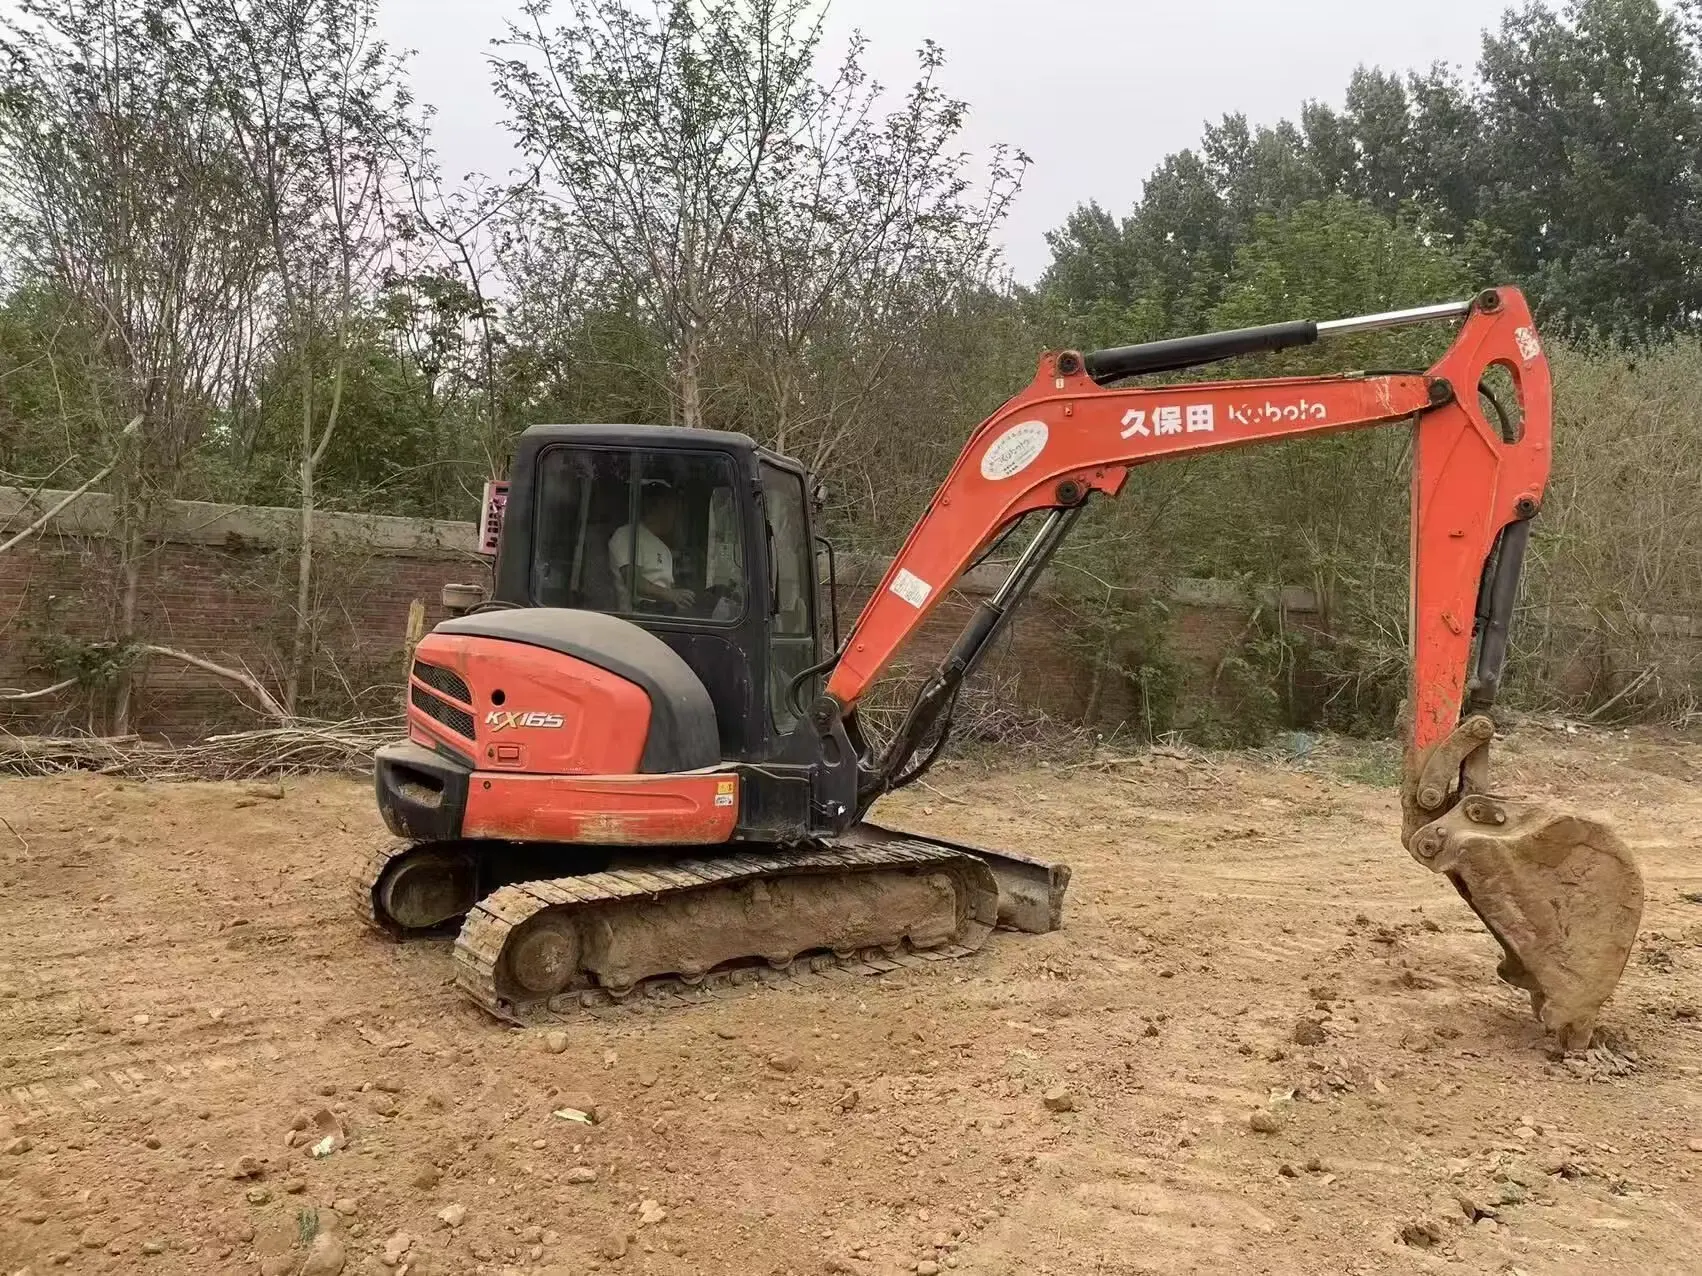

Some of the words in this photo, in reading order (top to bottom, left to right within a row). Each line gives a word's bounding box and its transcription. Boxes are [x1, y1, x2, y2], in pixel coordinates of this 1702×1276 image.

[1120, 404, 1215, 439] 久保田
[485, 711, 565, 732] KX165
